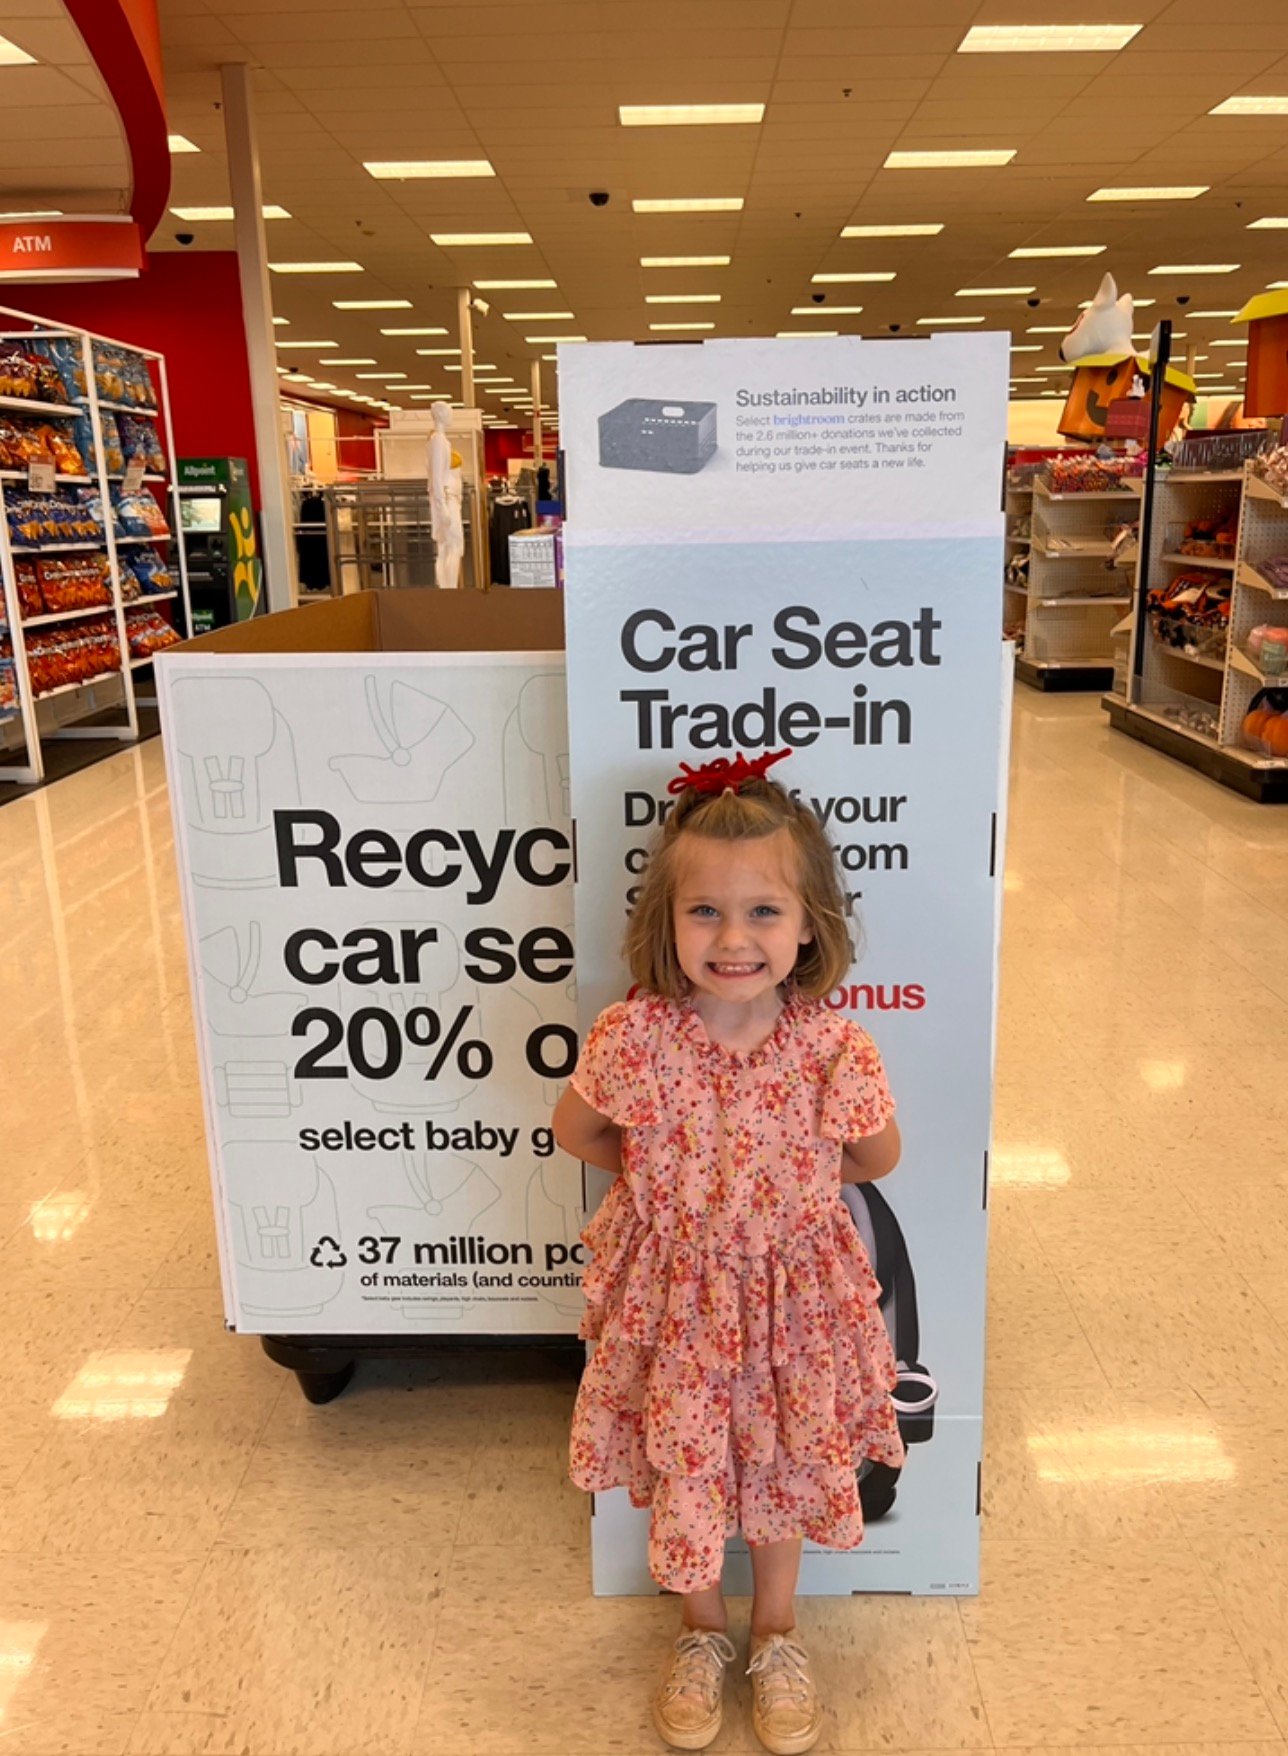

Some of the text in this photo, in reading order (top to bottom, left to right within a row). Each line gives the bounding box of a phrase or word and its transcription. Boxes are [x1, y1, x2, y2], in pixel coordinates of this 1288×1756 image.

[12, 235, 52, 254] ATM
[735, 384, 956, 408] Sustainability in action
[735, 411, 965, 427] Select brightroom crates are made from
[735, 425, 962, 442] the 2.6 million+ donations we've collected
[735, 439, 932, 458] during our trade-in event. Thanks for
[735, 455, 926, 473] helping us give car seats a new life.
[621, 605, 942, 673] Car Seat
[620, 683, 911, 749] Trade-in
[810, 793, 907, 827] your
[284, 928, 438, 985] car
[291, 1004, 493, 1081] 20%
[299, 1121, 415, 1150] select
[426, 1121, 519, 1156] baby
[358, 1236, 401, 1265] 37
[414, 1236, 532, 1265] million
[360, 1273, 378, 1286] of
[383, 1272, 468, 1287] materials
[473, 1271, 513, 1288] (and
